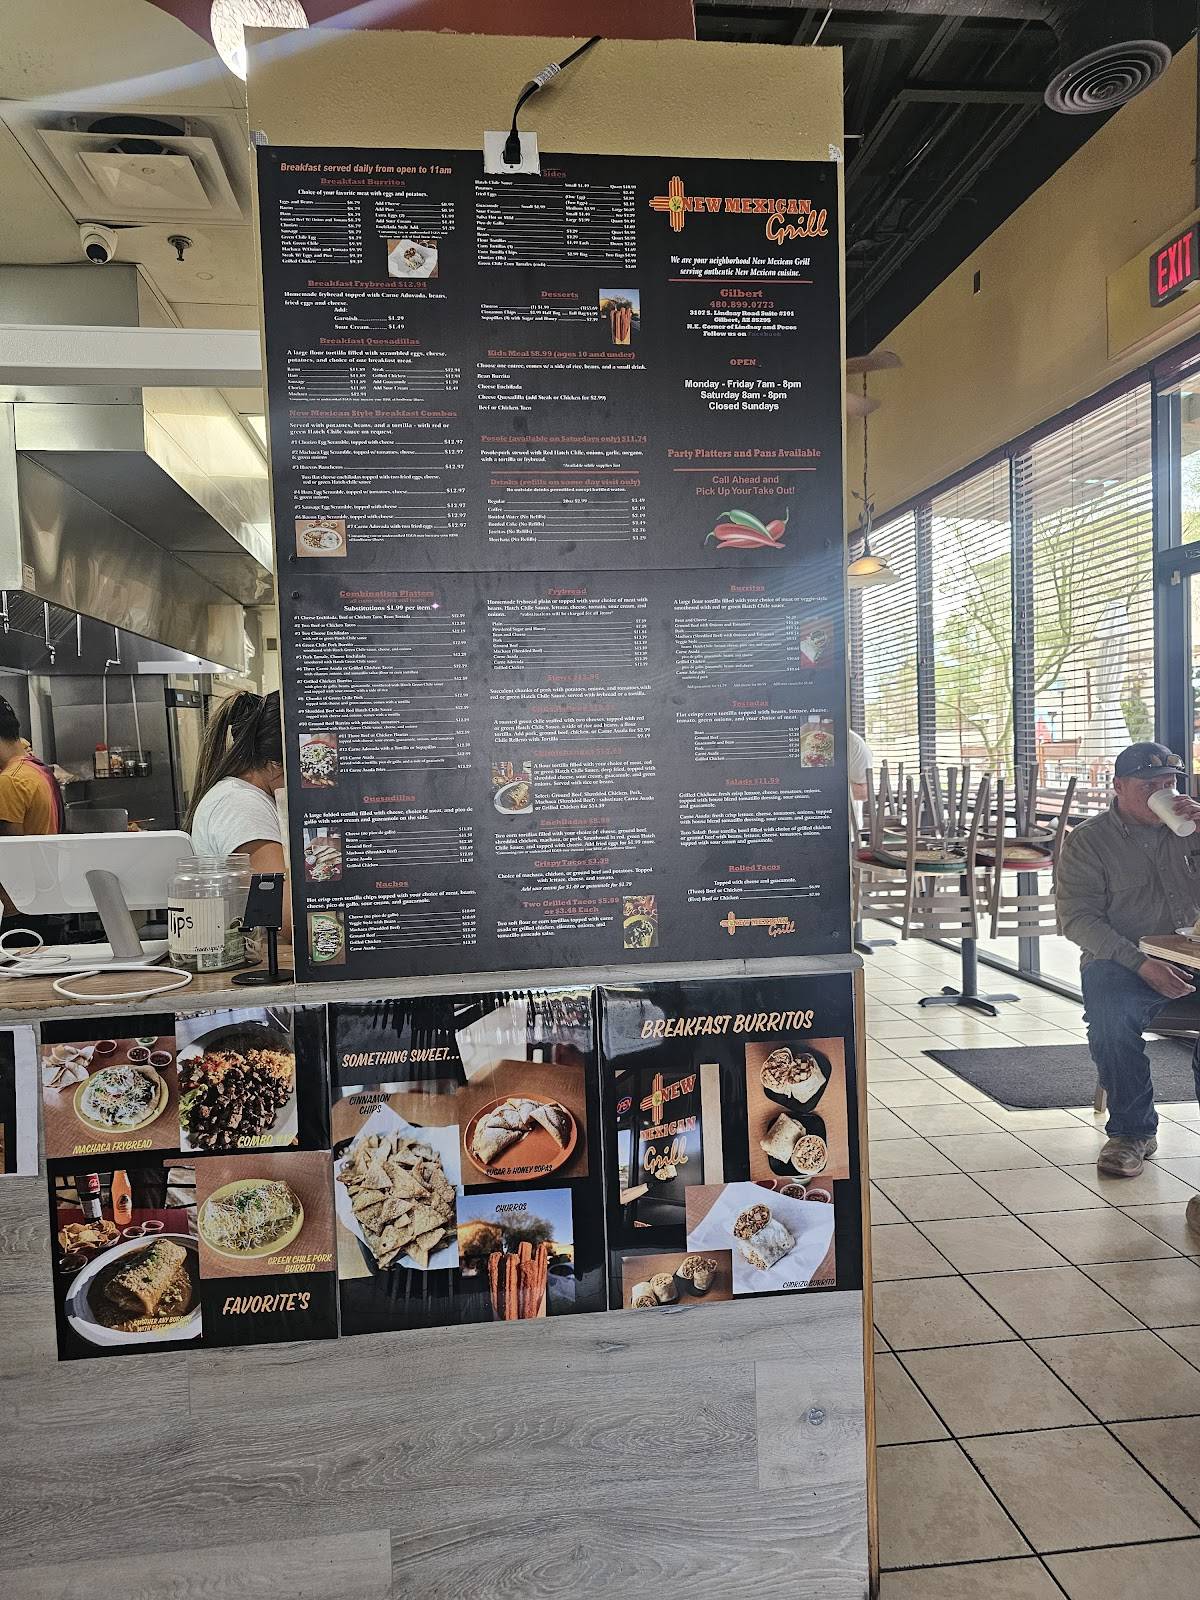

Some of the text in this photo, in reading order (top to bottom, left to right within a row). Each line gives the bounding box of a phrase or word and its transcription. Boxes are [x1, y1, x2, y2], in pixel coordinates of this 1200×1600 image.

[281, 163, 321, 172] Breakfast
[323, 164, 352, 172] served
[353, 164, 374, 174] daily
[375, 164, 394, 172] from
[396, 167, 416, 175] open
[430, 166, 452, 174] 11am
[367, 179, 405, 187] Burritos
[682, 196, 812, 216] NEW MEXICAN
[766, 208, 828, 245] Grill
[692, 258, 708, 266] your
[709, 256, 751, 267] neighborhood
[1157, 232, 1193, 296] EXIT
[680, 269, 703, 277] serving
[720, 289, 763, 297] Gilbert
[685, 380, 720, 390] Monday
[727, 380, 754, 390] Friday
[783, 380, 802, 389] 8pm
[701, 391, 740, 400] Saturday
[768, 391, 787, 400] 8pm
[742, 402, 779, 412] Sundays
[668, 449, 693, 460] Party
[695, 449, 732, 458] Platters
[734, 449, 752, 457] and
[754, 449, 776, 457] Pans
[718, 487, 730, 496] Up
[732, 487, 752, 495] Your
[534, 860, 562, 868] Crispy
[376, 881, 408, 889] Nachos
[168, 907, 194, 938] Tips
[641, 1010, 815, 1040] BREAKFAST BURRITOS
[342, 1046, 460, 1068] SOMETHING SWEET...
[662, 1074, 696, 1102] NEW
[349, 1094, 391, 1106] CINNAMON
[359, 1104, 382, 1115] CHIPS
[640, 1116, 696, 1142] MEXICAN
[73, 1139, 153, 1154] MACHACA FRYBREAD
[237, 1134, 273, 1148] COMBO
[644, 1136, 688, 1174] Grill
[513, 1166, 533, 1174] HONEY
[496, 1203, 527, 1212] CHURROS
[268, 1254, 332, 1265] GREEN CHILE PORK
[285, 1264, 316, 1273] BURRITO
[783, 1280, 808, 1288] CHORIZO
[222, 1292, 311, 1315] FAVORITE'S
